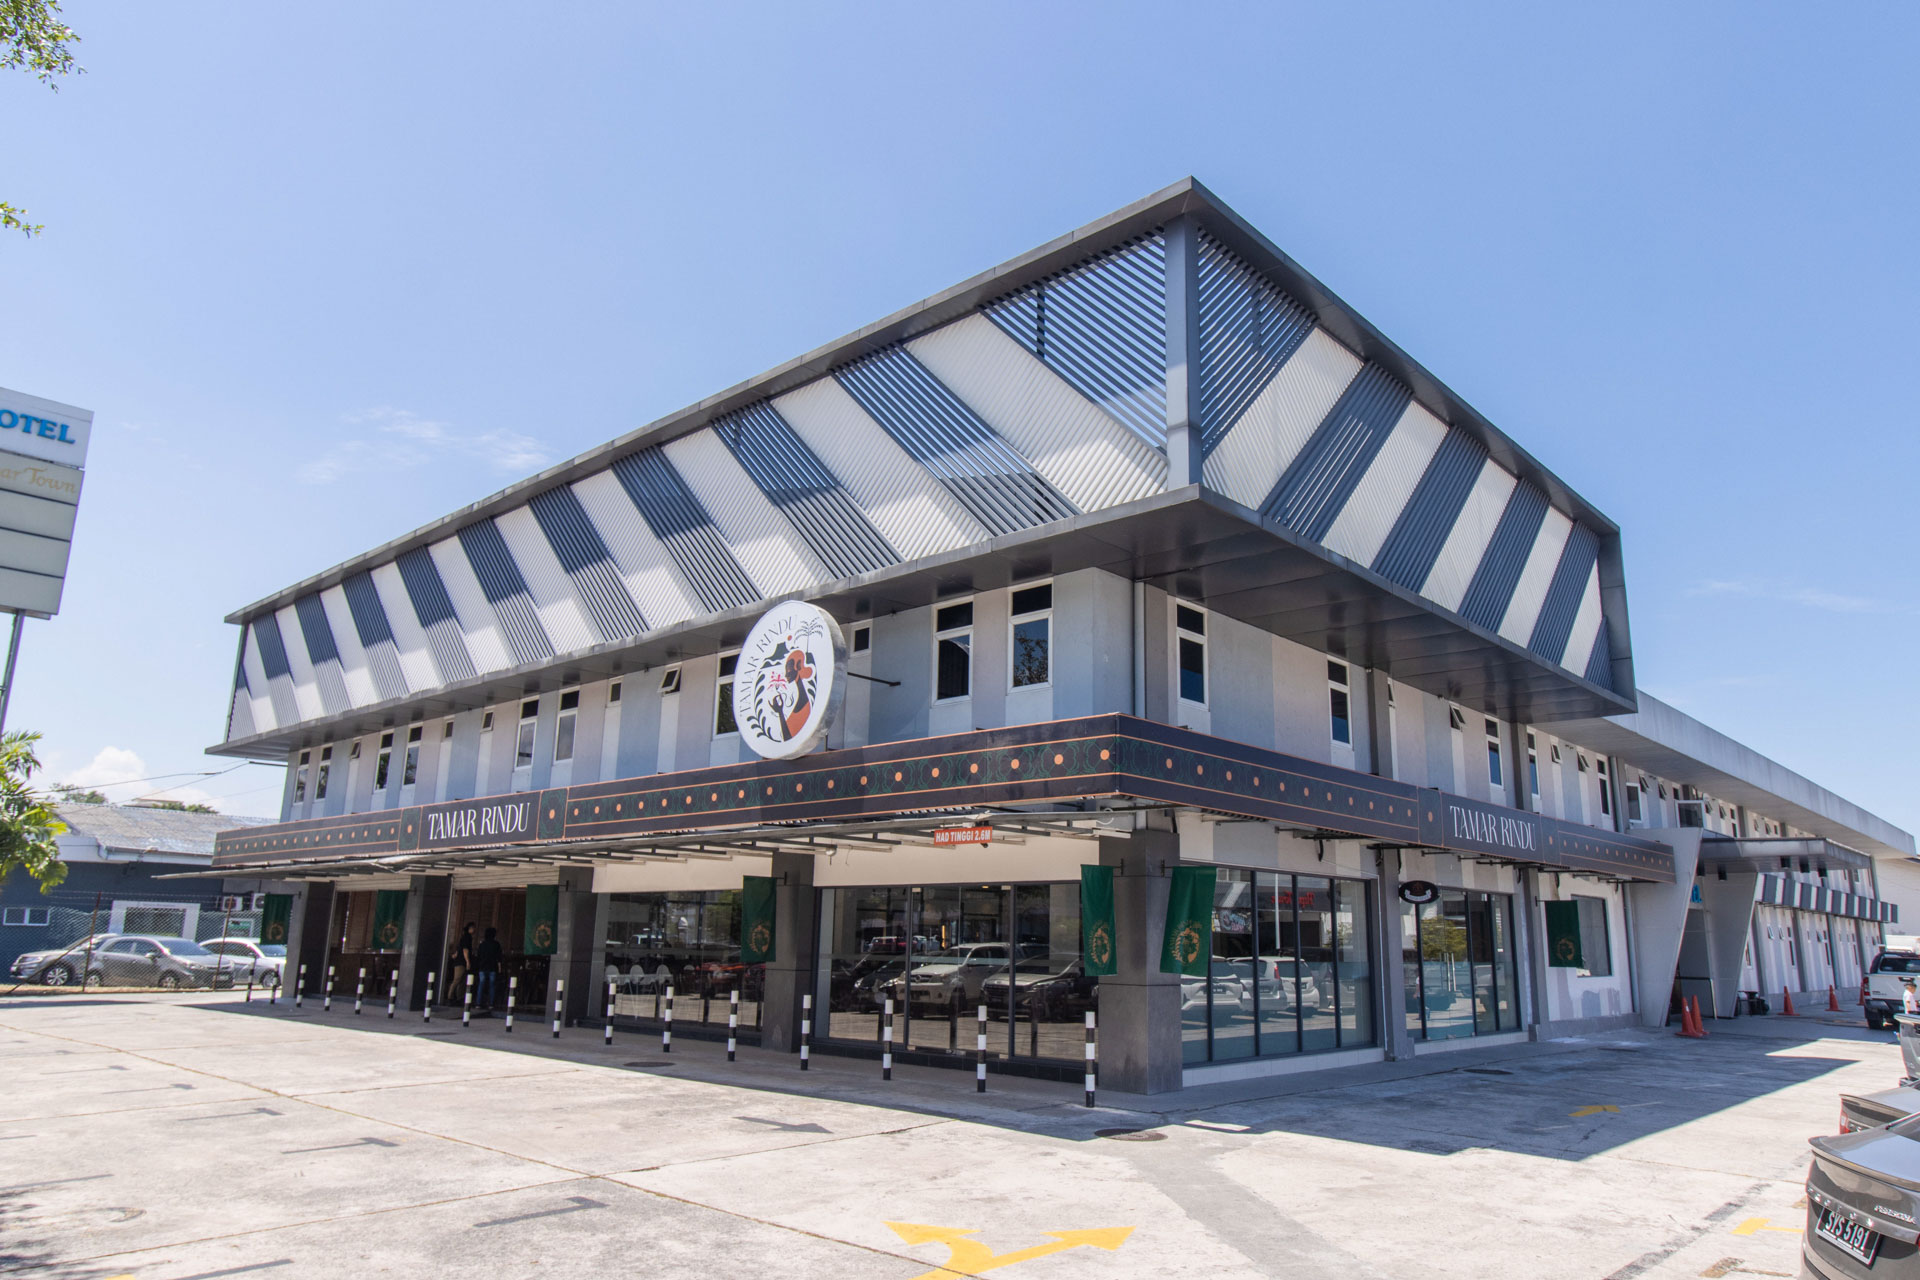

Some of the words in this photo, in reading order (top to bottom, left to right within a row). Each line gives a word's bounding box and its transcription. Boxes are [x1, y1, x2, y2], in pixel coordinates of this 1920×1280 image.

[24, 467, 76, 494] Town
[756, 614, 798, 653] RINDU
[428, 809, 476, 840] TAMAR
[480, 802, 531, 836] RINDU
[935, 832, 949, 842] HAD
[950, 830, 973, 842] TINGGI
[974, 829, 991, 841] 2.6M
[1449, 805, 1498, 844] TAMAR
[1500, 816, 1537, 851] RINDU
[1825, 1211, 1845, 1236] SYS
[1844, 1220, 1871, 1251] 5191
